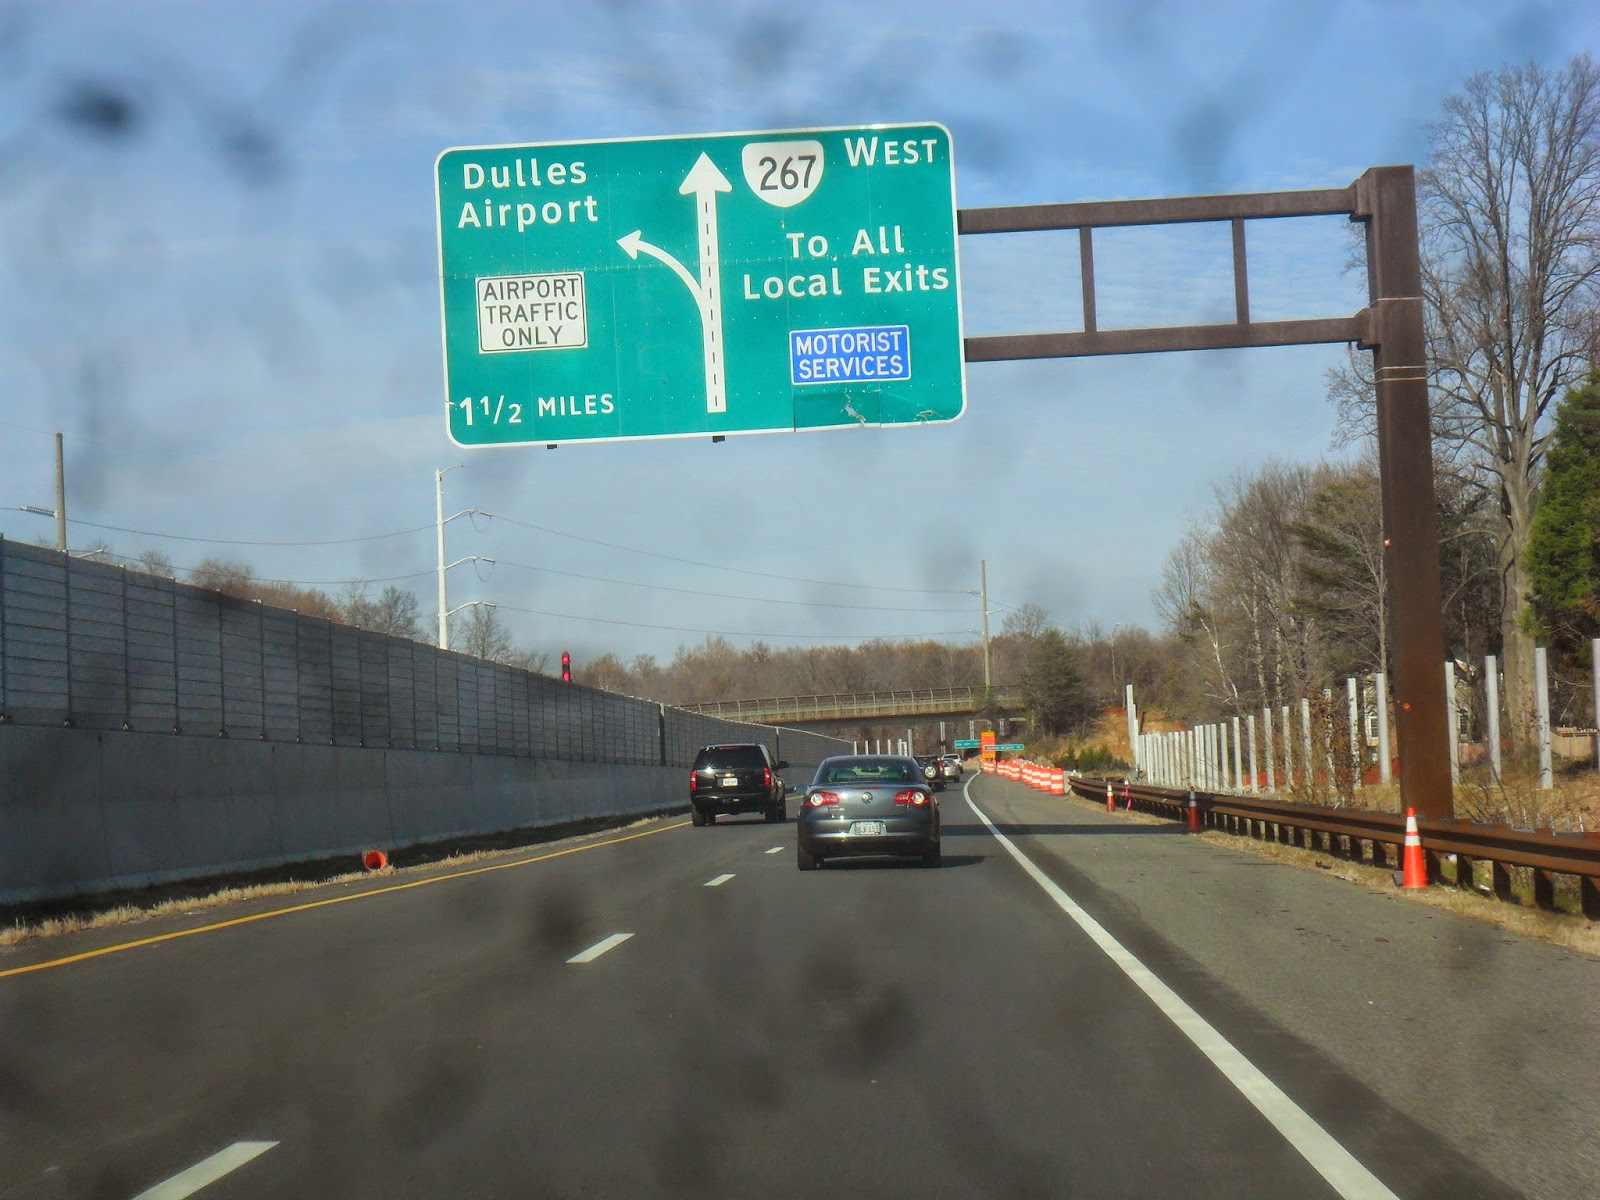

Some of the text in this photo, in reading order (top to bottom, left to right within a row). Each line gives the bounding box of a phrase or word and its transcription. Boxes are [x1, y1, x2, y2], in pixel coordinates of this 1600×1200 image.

[844, 137, 938, 167] WEST
[464, 158, 586, 190] Dulles
[759, 155, 816, 191] 267
[458, 195, 598, 232] Airport
[786, 225, 904, 258] To All
[483, 278, 578, 302] AIRPORT
[744, 261, 949, 299] Local Exits
[485, 301, 578, 324] TRAFFIC
[502, 325, 562, 347] ONLY
[796, 332, 902, 354] MOTORIST
[799, 355, 904, 379] SERVICES
[538, 394, 614, 417] MILES
